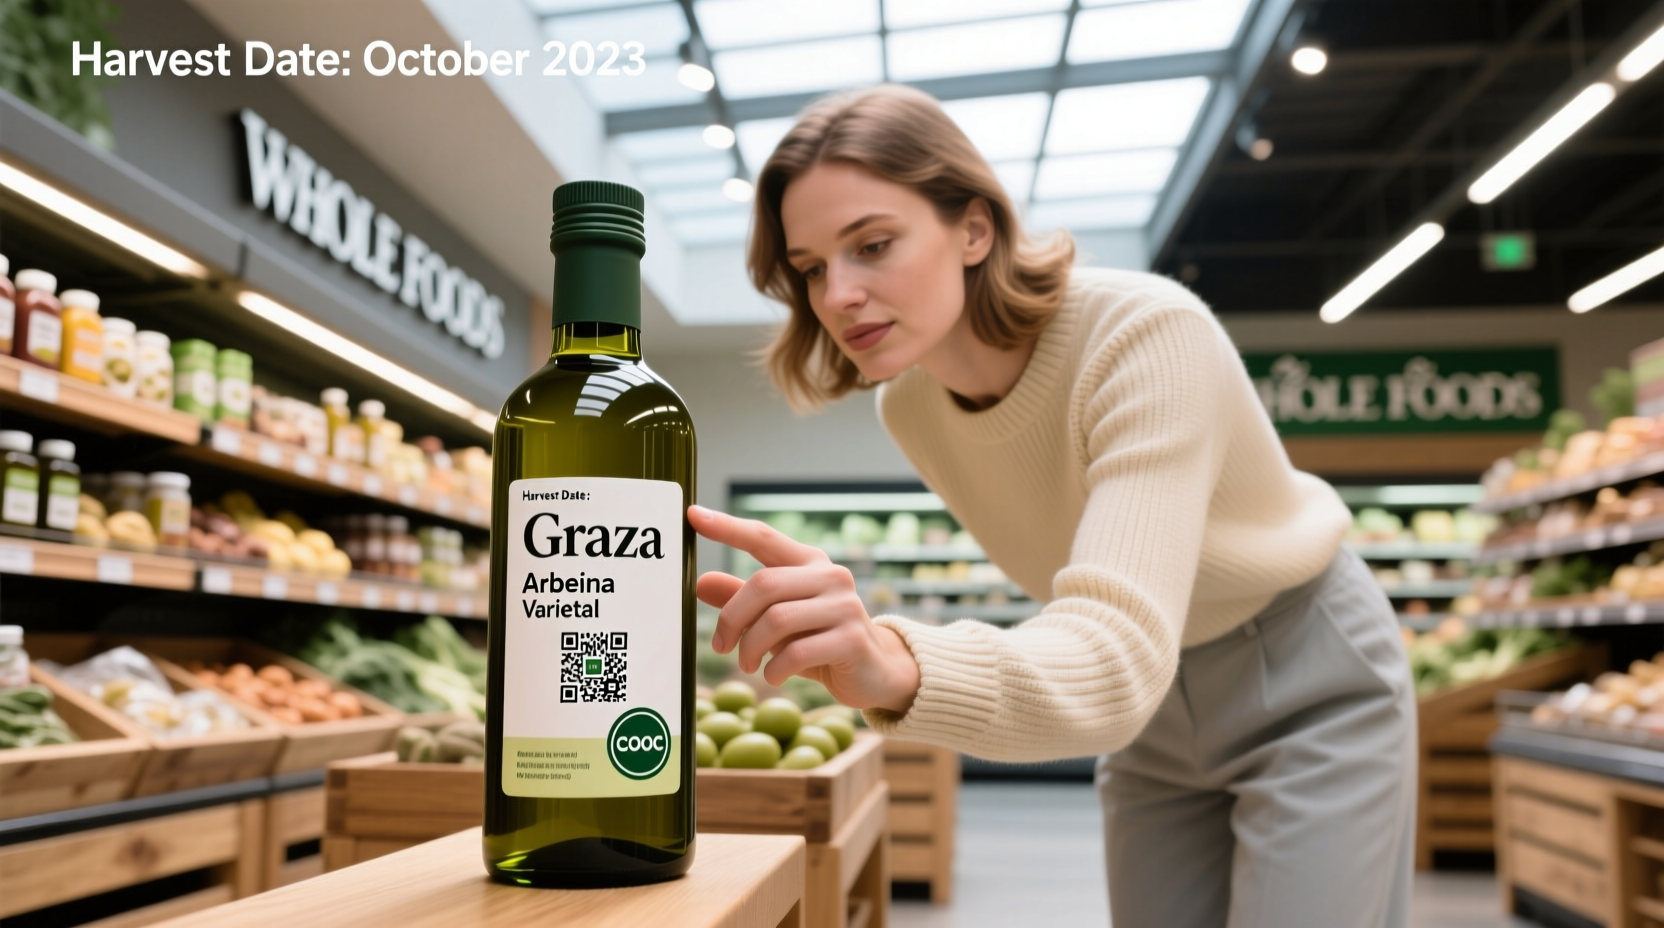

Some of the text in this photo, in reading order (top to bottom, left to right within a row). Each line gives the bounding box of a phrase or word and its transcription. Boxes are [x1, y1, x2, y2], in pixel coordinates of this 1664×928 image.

[240, 107, 505, 359] WHOLE FOODS
[1251, 358, 1543, 423] HOLE FOODS
[522, 490, 591, 501] Harvest Date:
[523, 512, 665, 559] Graza
[522, 571, 615, 593] Arbeina
[522, 599, 599, 618] Varietal
[616, 735, 664, 752] COOC
